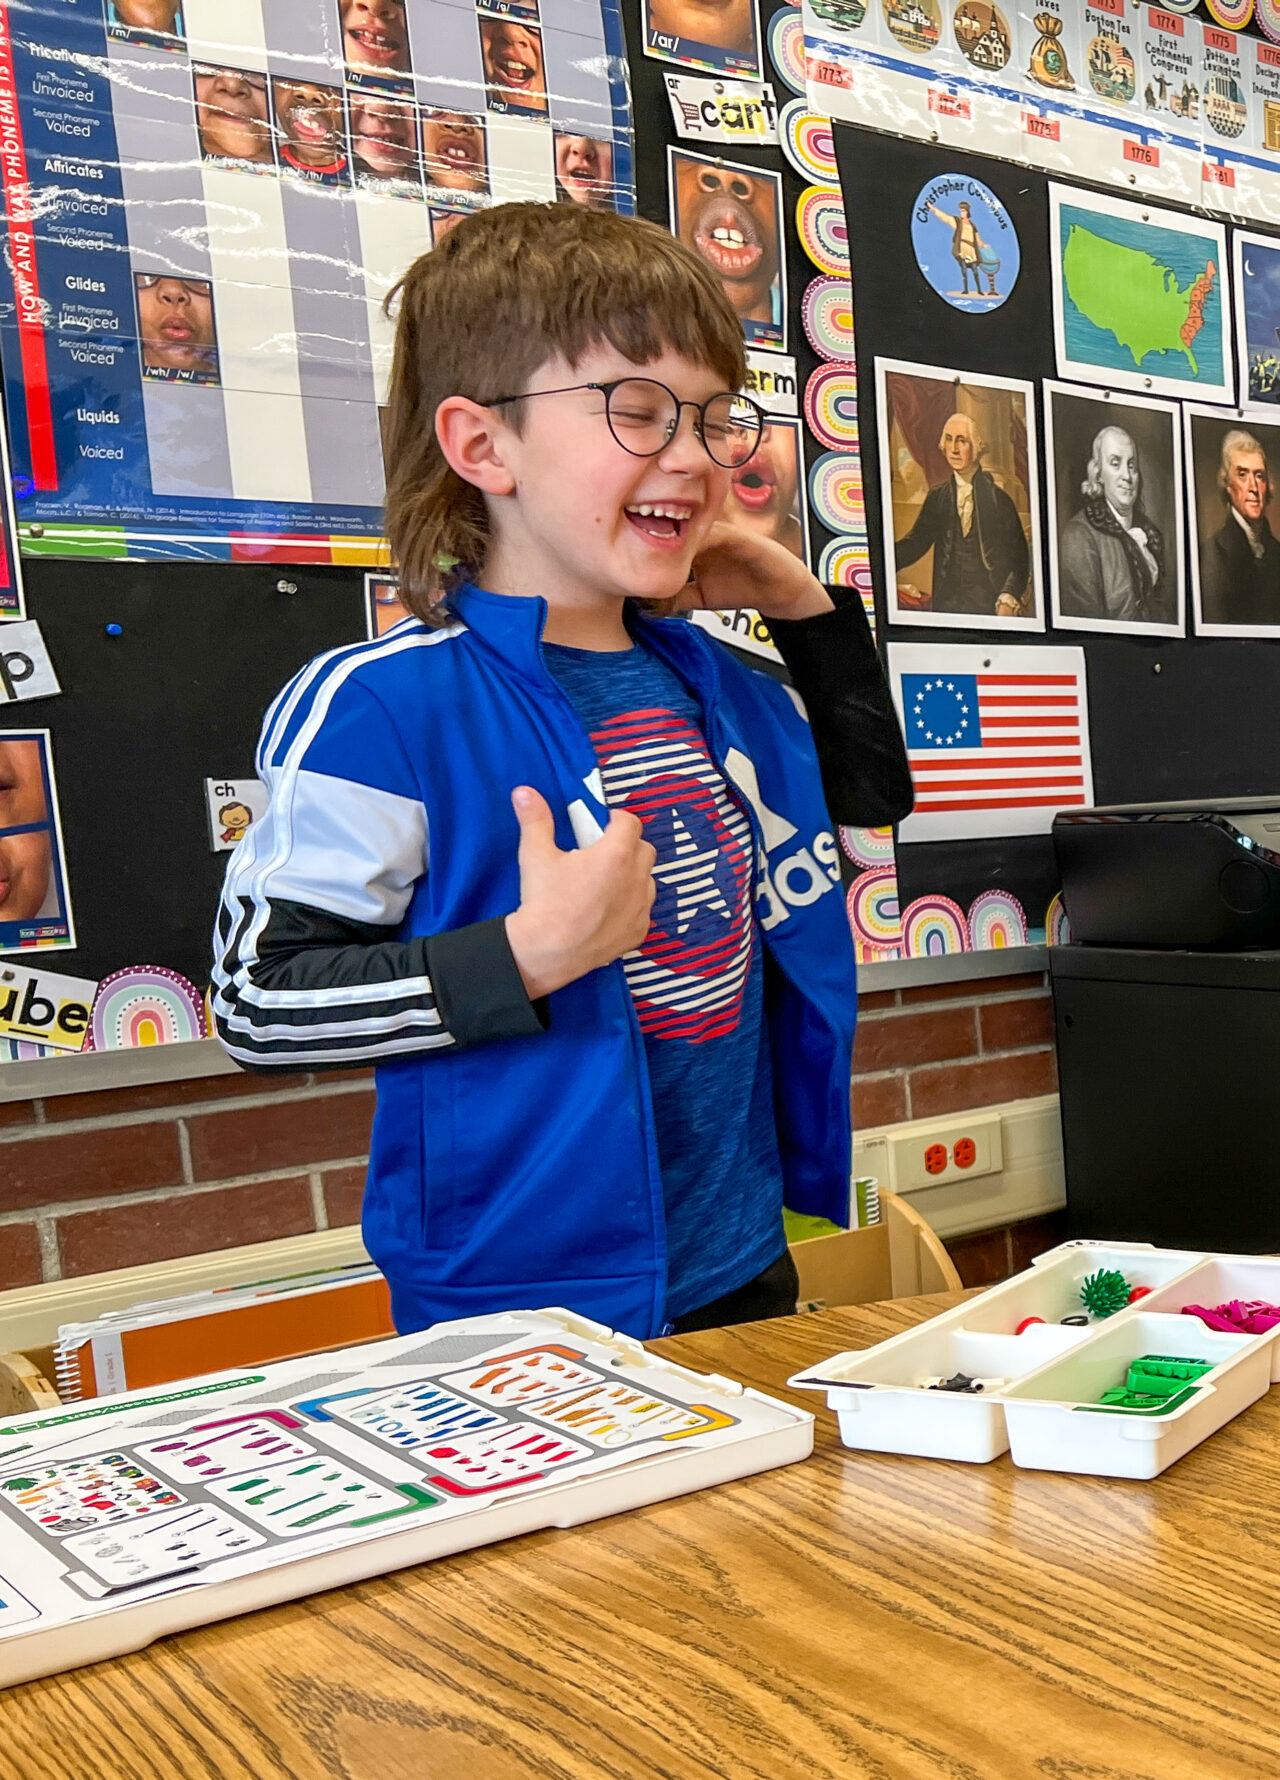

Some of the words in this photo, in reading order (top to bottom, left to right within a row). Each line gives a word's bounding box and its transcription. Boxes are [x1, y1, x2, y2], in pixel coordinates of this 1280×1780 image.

[1086, 10, 1116, 29] Boston
[1115, 20, 1131, 34] Tea
[1157, 14, 1177, 30] 1774
[1097, 21, 1120, 44] Party
[1212, 33, 1230, 48] 1775
[651, 31, 680, 52] /ar/
[1158, 34, 1178, 49] First
[1145, 41, 1192, 66] Continental
[1150, 55, 1188, 75] Congress
[1203, 59, 1242, 79] Lexington
[32, 81, 94, 102] Unvoiced
[667, 77, 680, 90] ar
[700, 90, 776, 131] cart
[45, 119, 91, 137] Voiced
[1029, 119, 1052, 136] 1775
[1131, 147, 1152, 163] 1776
[44, 159, 104, 179] Affricates
[916, 179, 965, 224] Christopher
[65, 276, 106, 293] Glides
[70, 350, 115, 365] Voiced
[77, 409, 120, 425] Liquids
[79, 444, 124, 460] Voiced
[214, 782, 236, 797] ch
